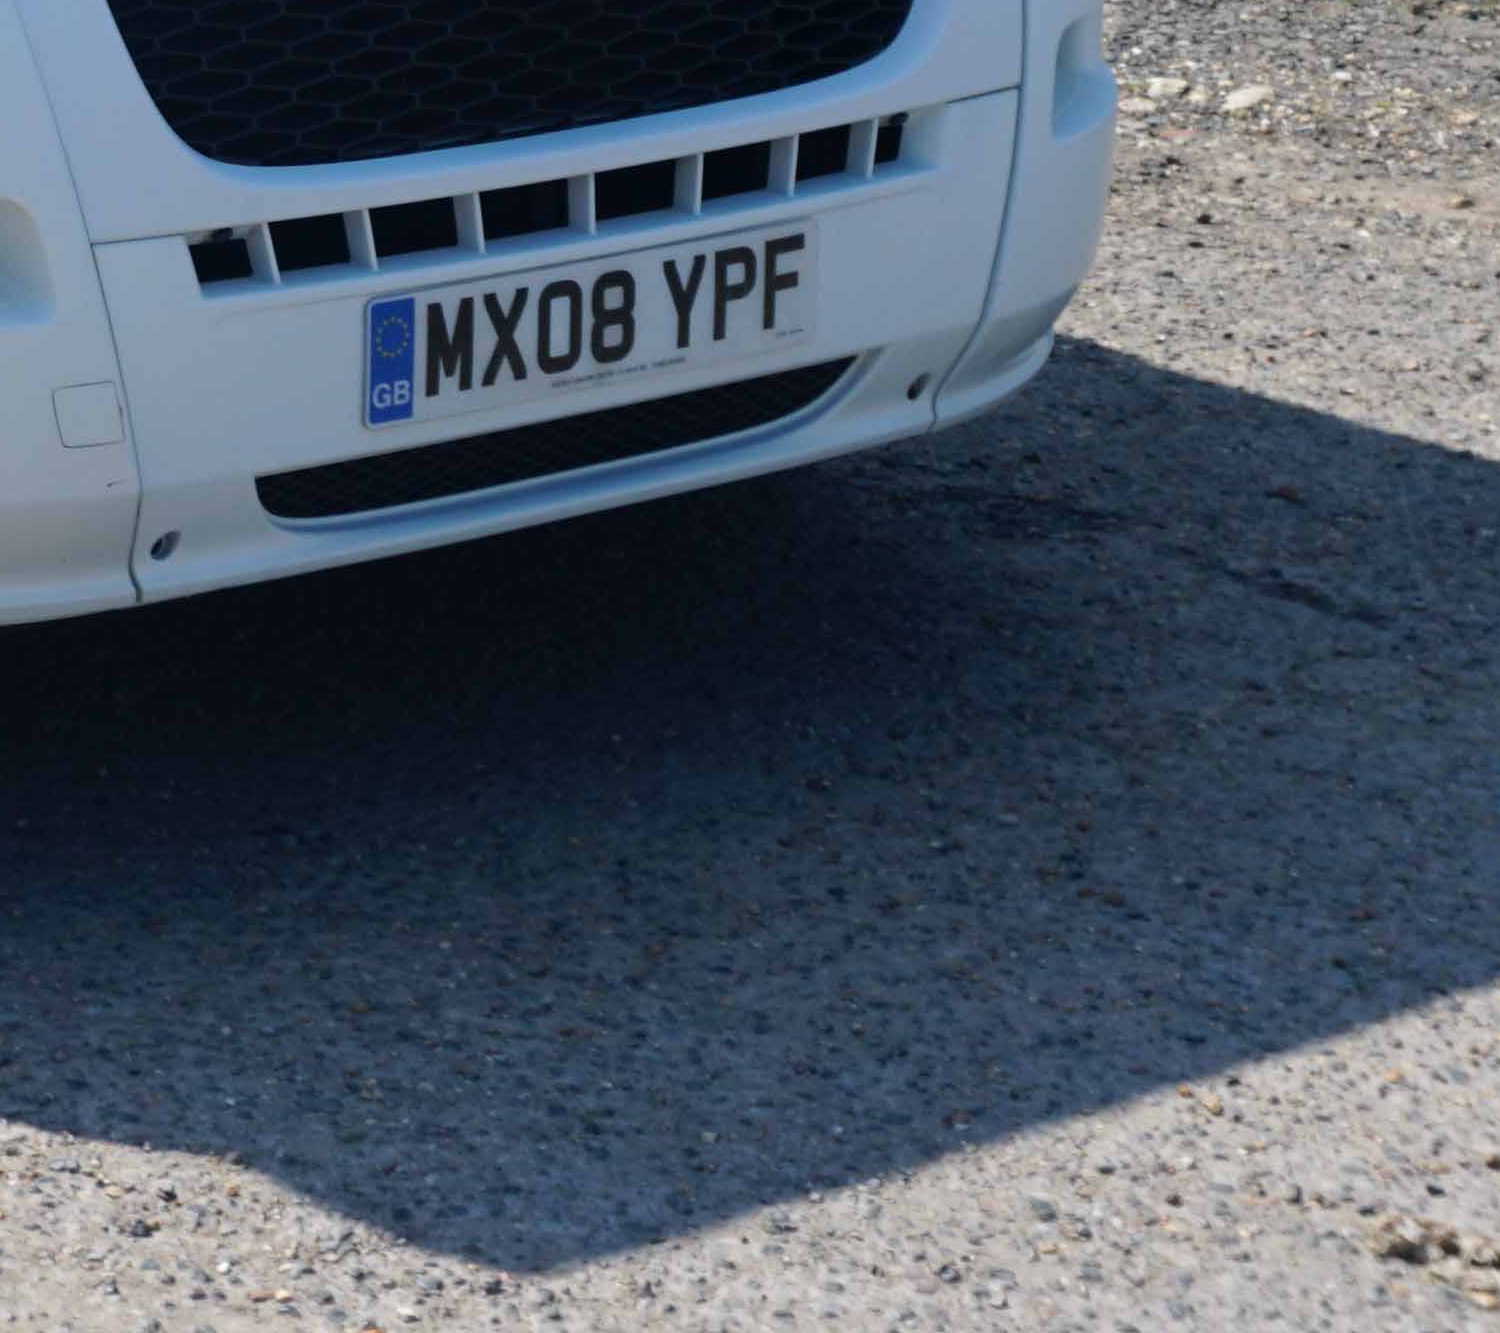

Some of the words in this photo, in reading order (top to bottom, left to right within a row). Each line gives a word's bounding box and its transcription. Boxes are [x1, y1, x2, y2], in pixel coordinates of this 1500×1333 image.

[424, 268, 637, 398] MX08
[662, 232, 806, 350] YPF
[371, 379, 412, 411] GB
